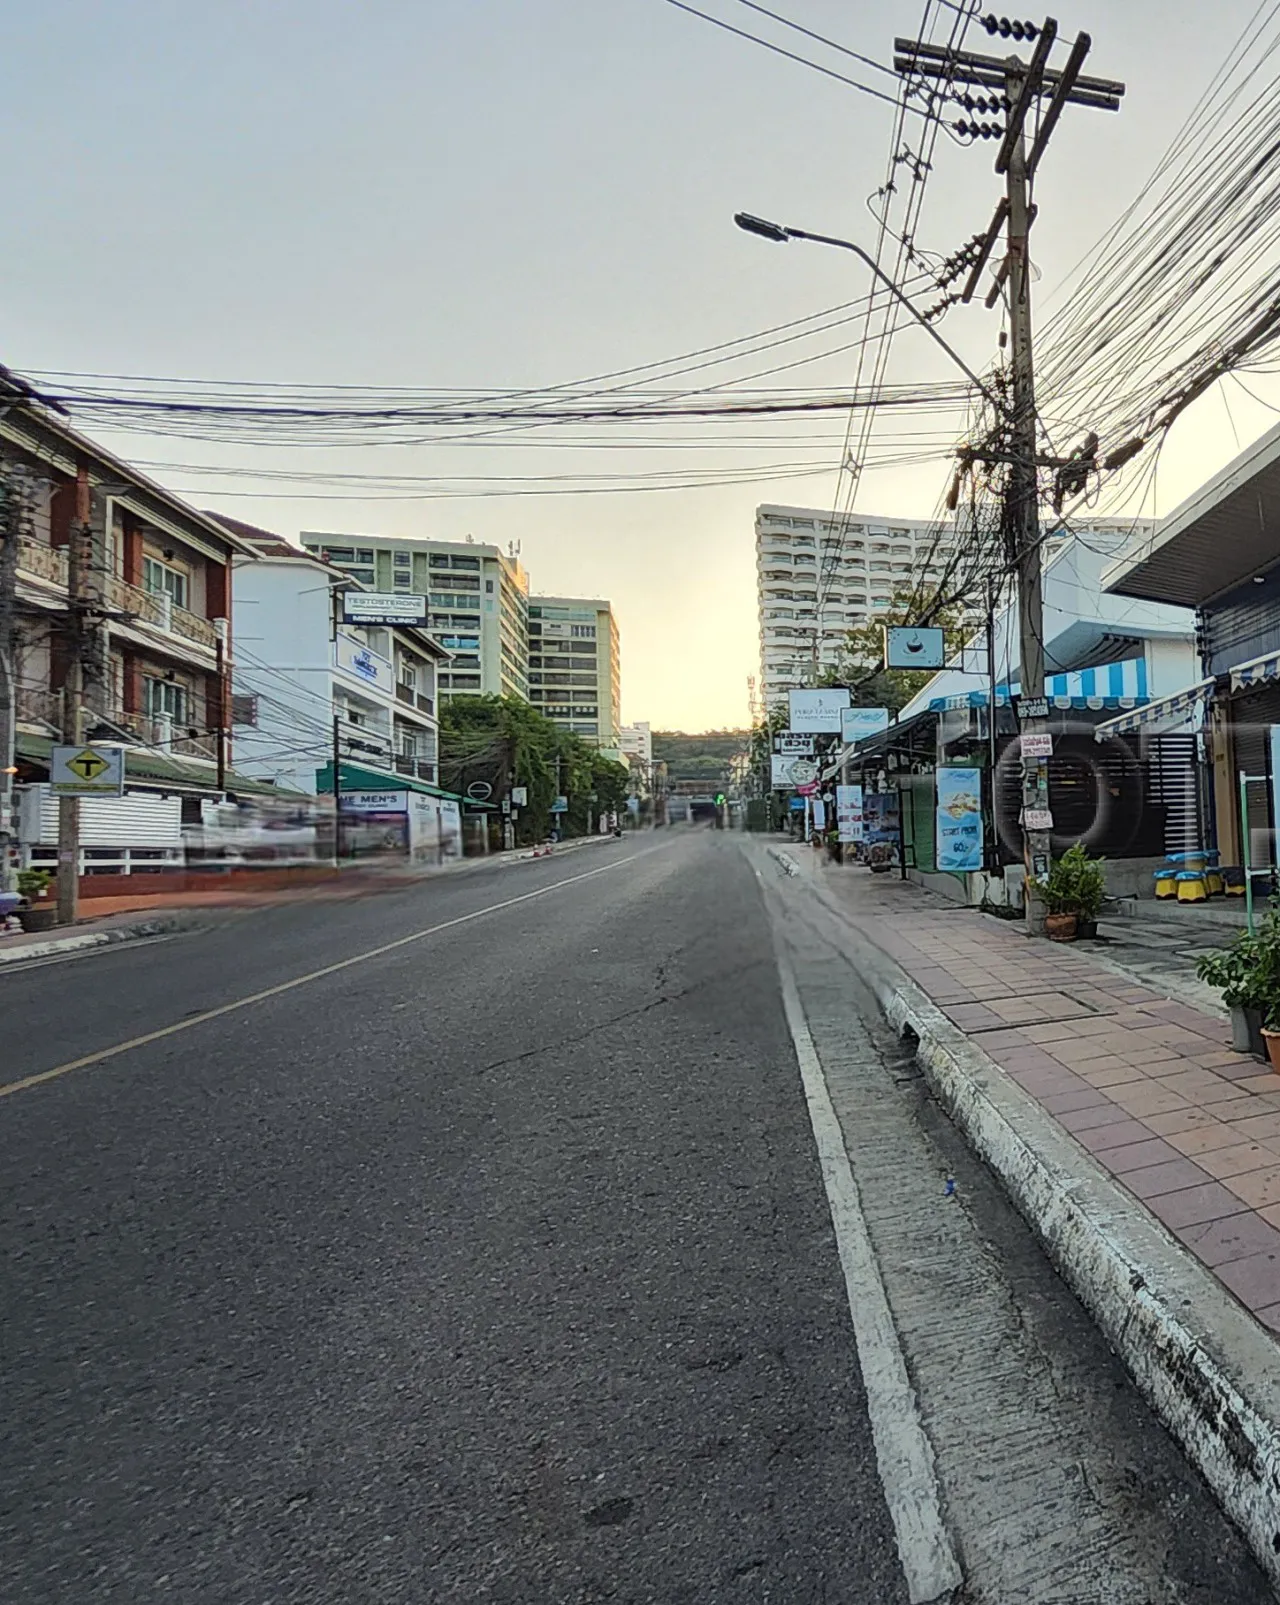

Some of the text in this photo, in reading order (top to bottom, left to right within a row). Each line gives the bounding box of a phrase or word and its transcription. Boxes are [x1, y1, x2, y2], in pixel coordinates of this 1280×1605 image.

[348, 597, 421, 607] TESTOSTERONE
[386, 616, 417, 624] CLINIC
[361, 795, 397, 803] MEN'S
[961, 825, 977, 834] FROM
